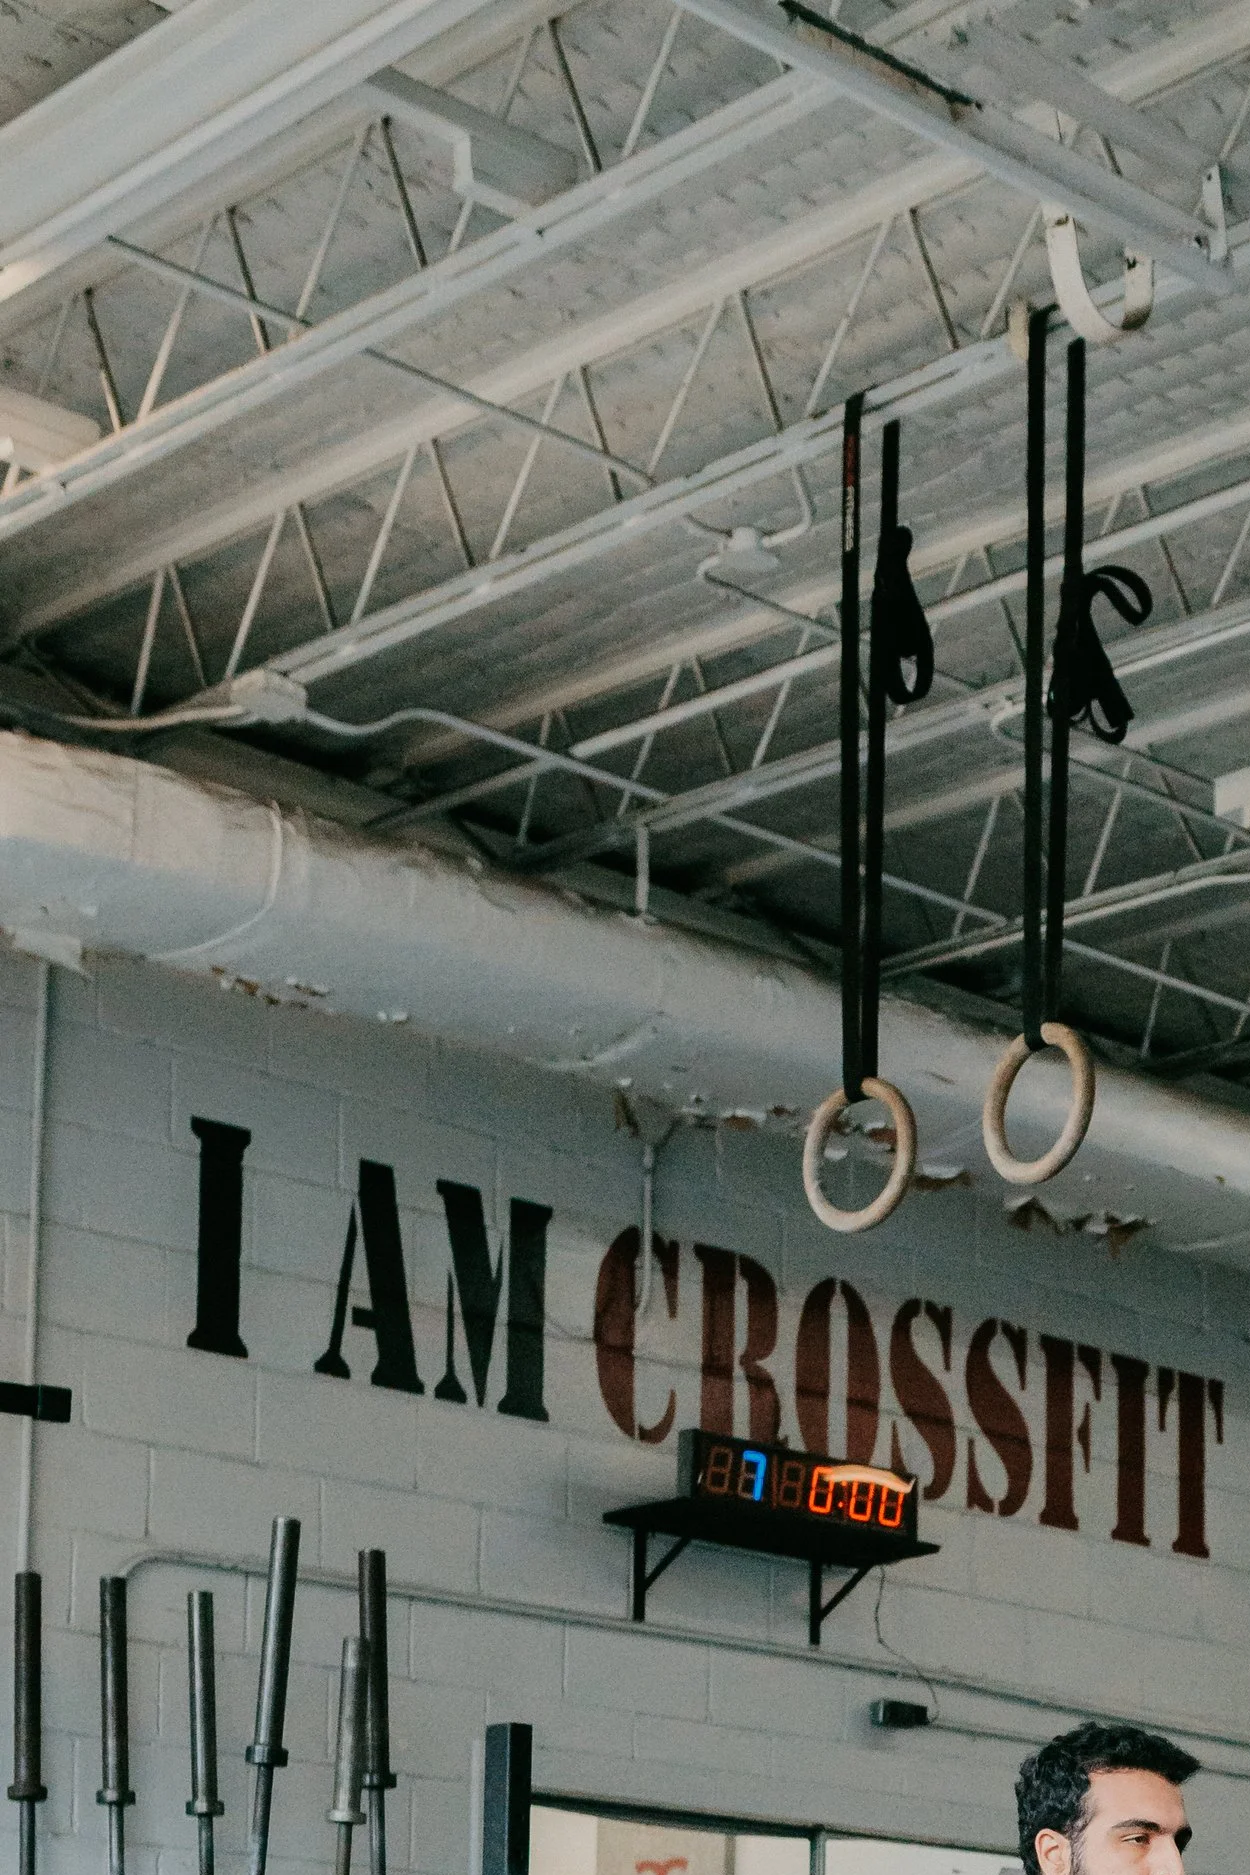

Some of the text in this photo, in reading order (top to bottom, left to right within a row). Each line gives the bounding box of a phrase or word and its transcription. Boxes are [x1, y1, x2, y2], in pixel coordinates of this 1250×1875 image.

[187, 1116, 1224, 1559] I AM CROSSFIT
